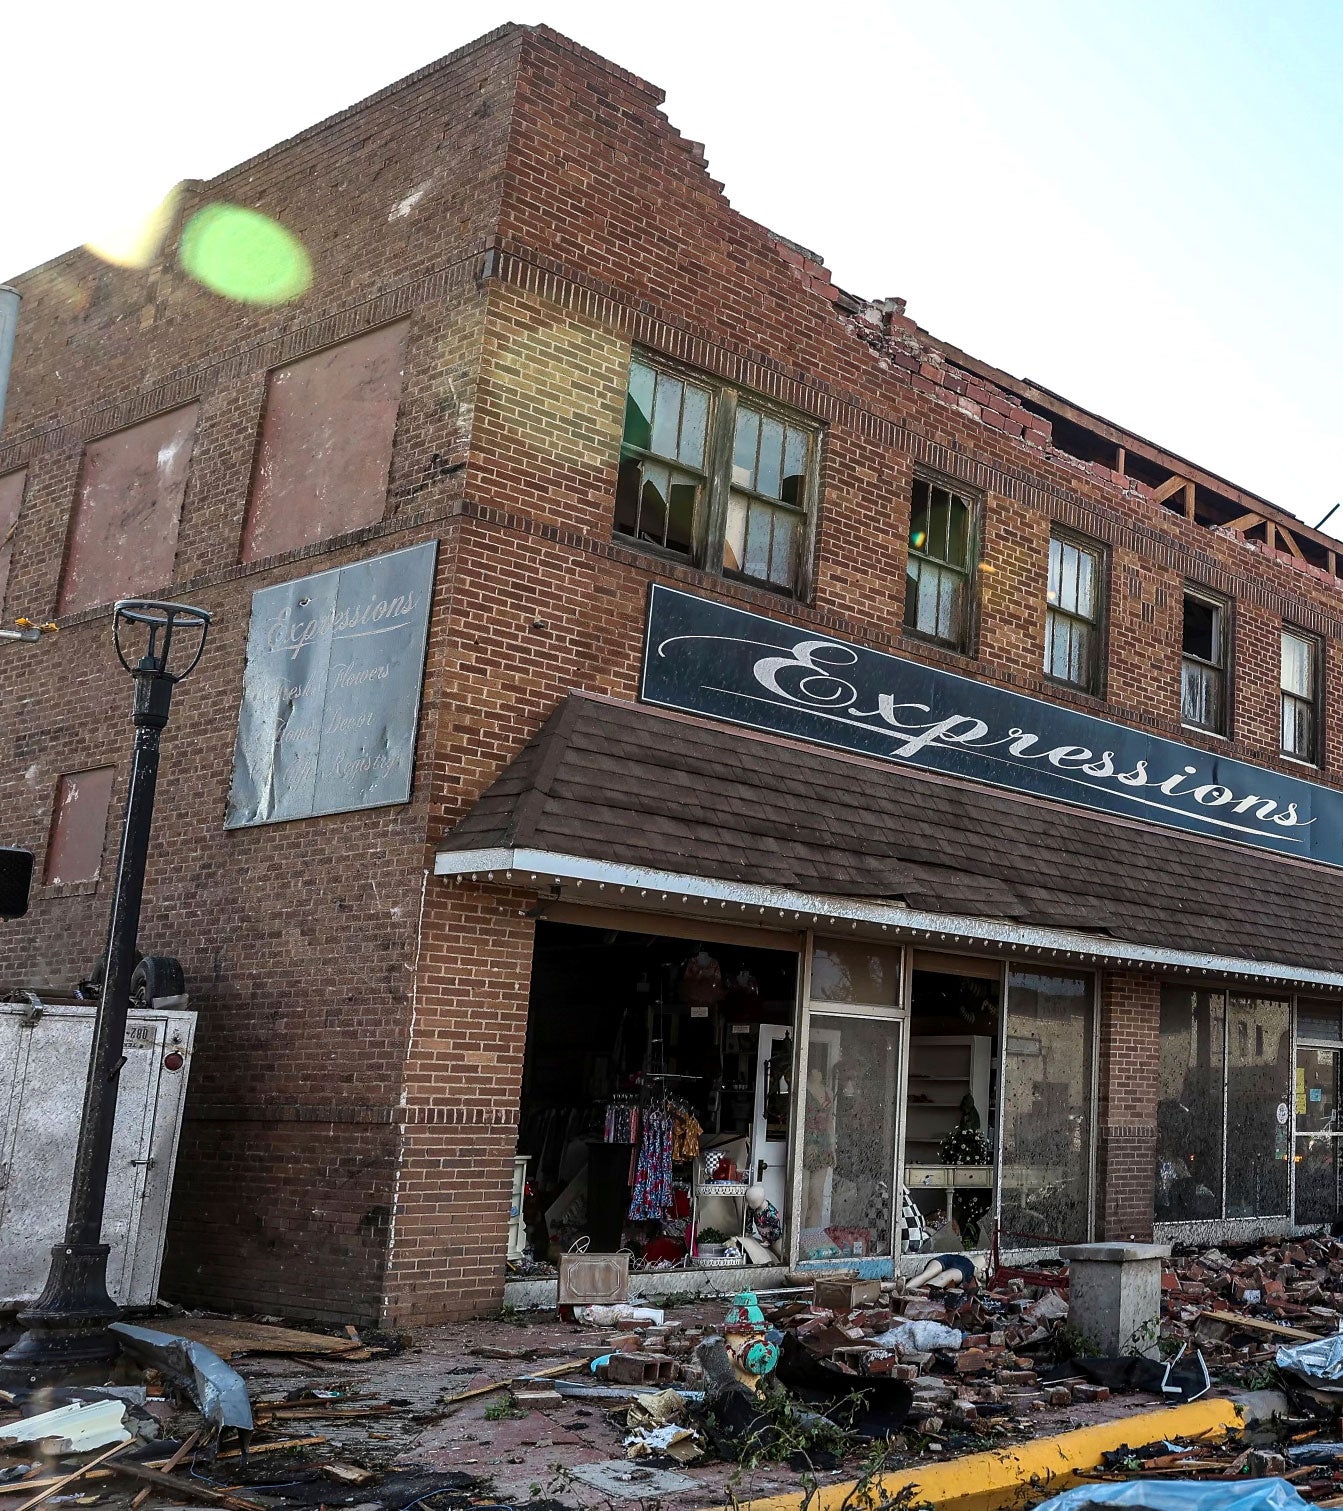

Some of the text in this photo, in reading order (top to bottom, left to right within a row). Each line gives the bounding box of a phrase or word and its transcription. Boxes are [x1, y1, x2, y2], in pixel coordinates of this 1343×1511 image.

[265, 590, 421, 660] Expressions
[328, 661, 390, 693] Flowers
[325, 705, 374, 735] Decor
[658, 636, 1317, 824] Expressions
[329, 750, 400, 785] Registry
